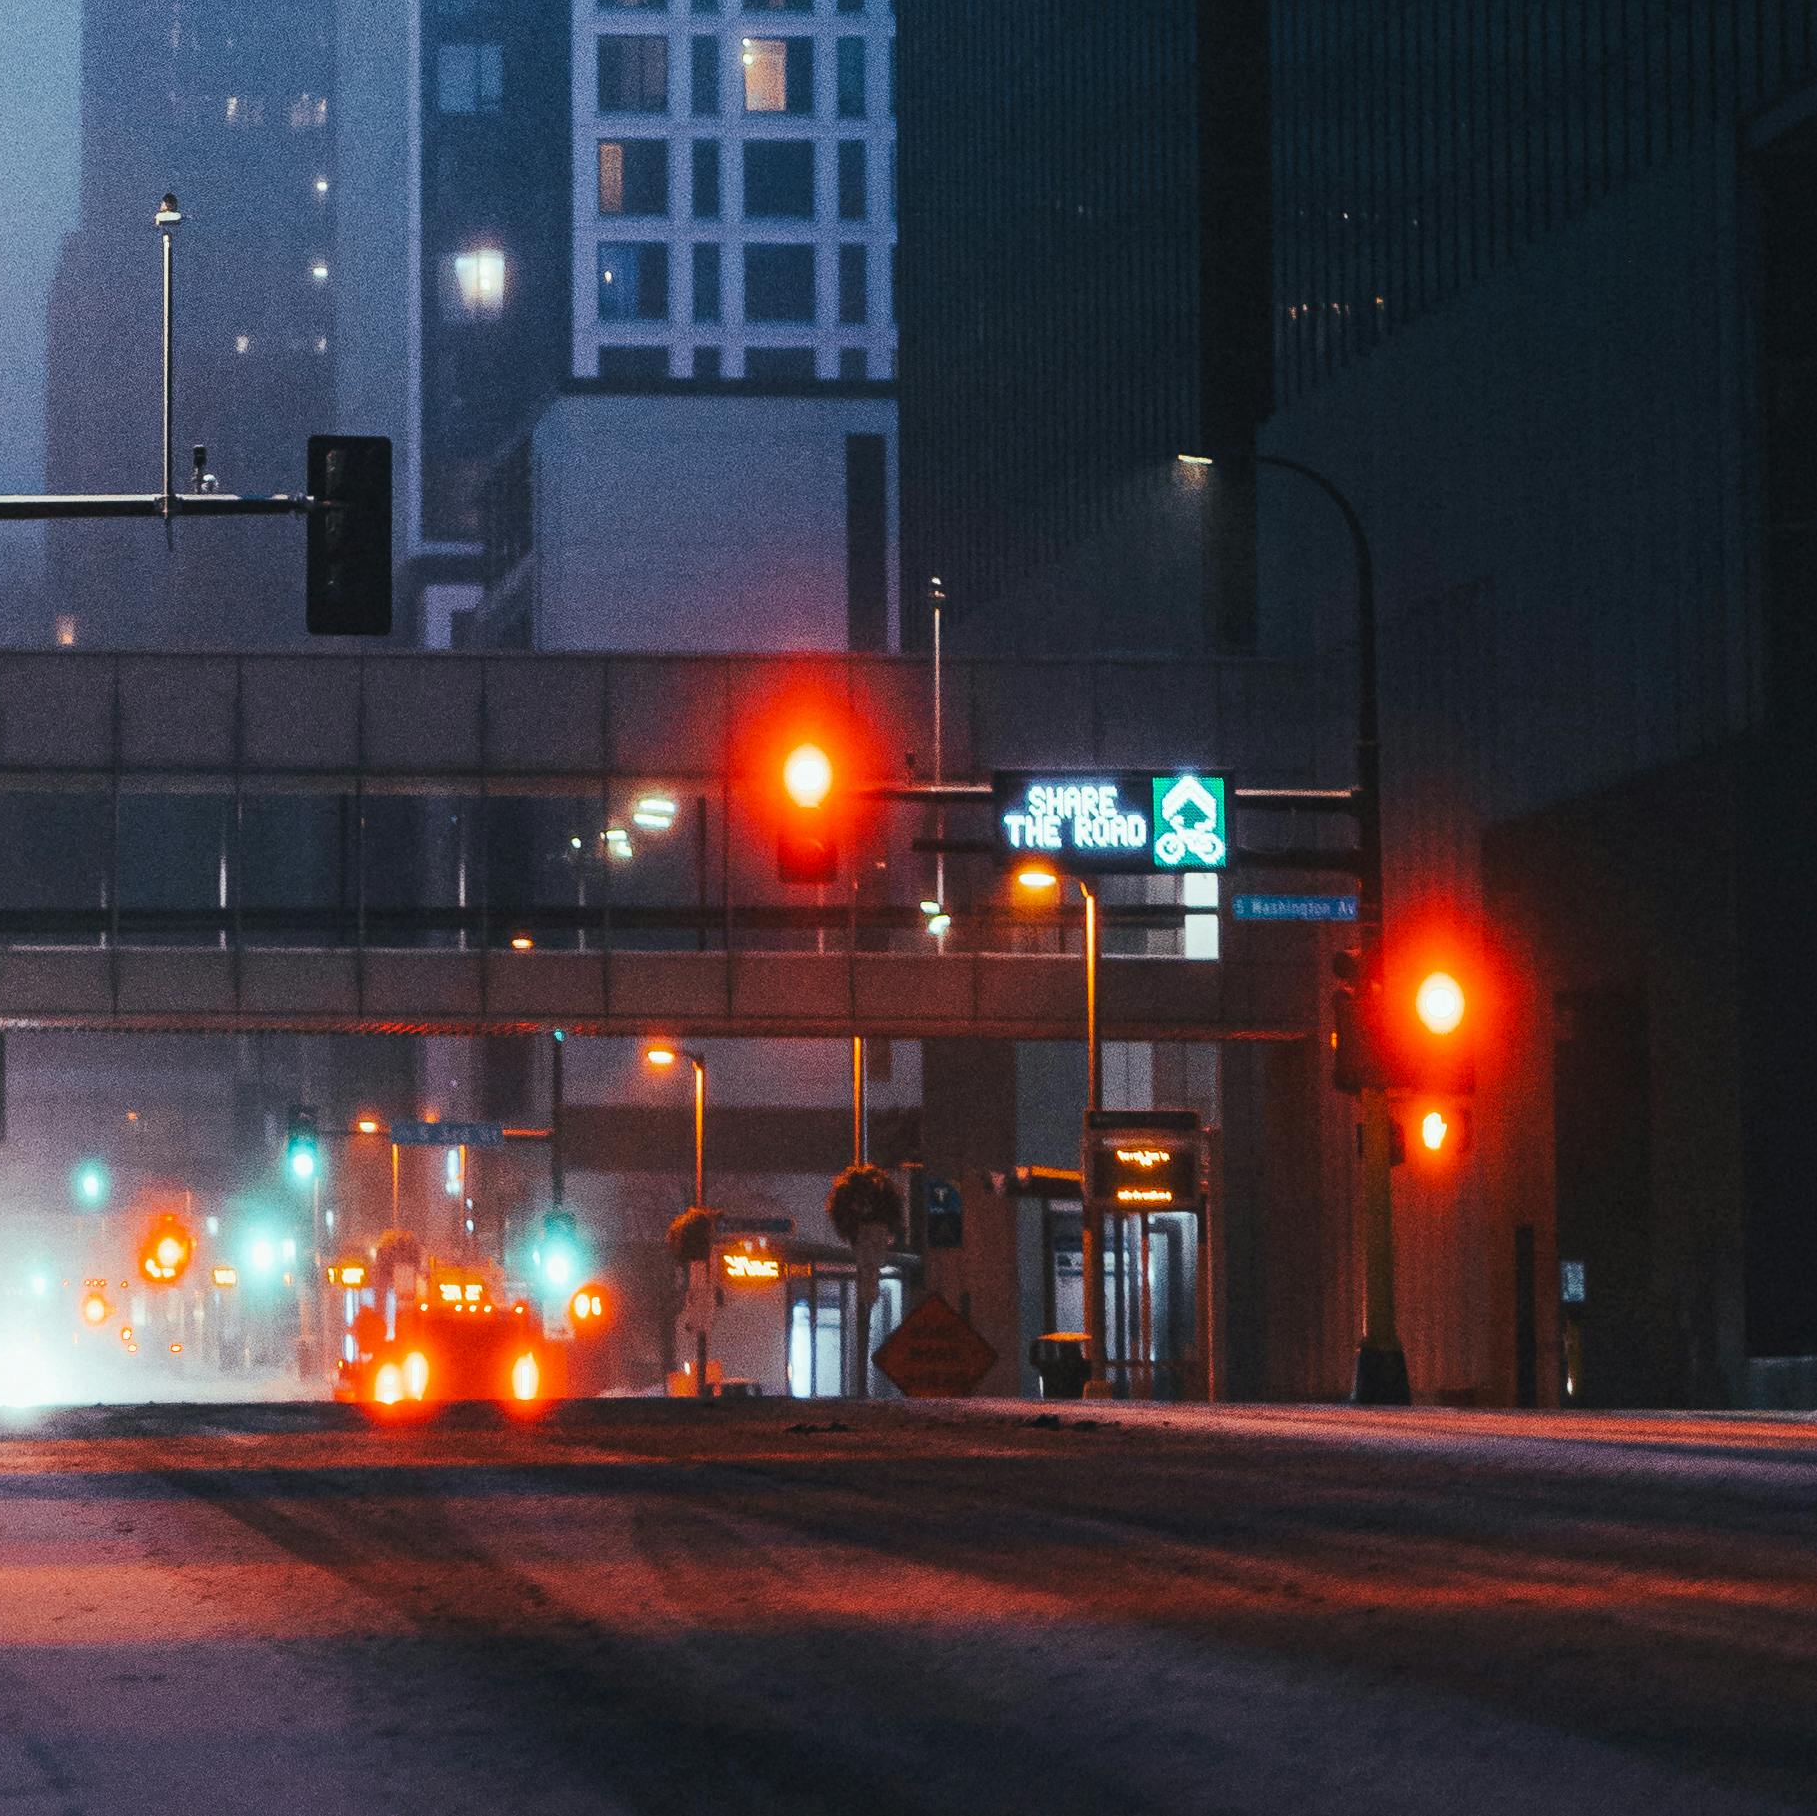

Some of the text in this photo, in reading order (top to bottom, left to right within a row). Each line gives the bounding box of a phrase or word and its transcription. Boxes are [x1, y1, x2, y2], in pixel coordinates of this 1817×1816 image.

[1028, 785, 1118, 818] SHARE
[1004, 814, 1147, 848] THE ROAD
[1251, 899, 1331, 920] Washington
